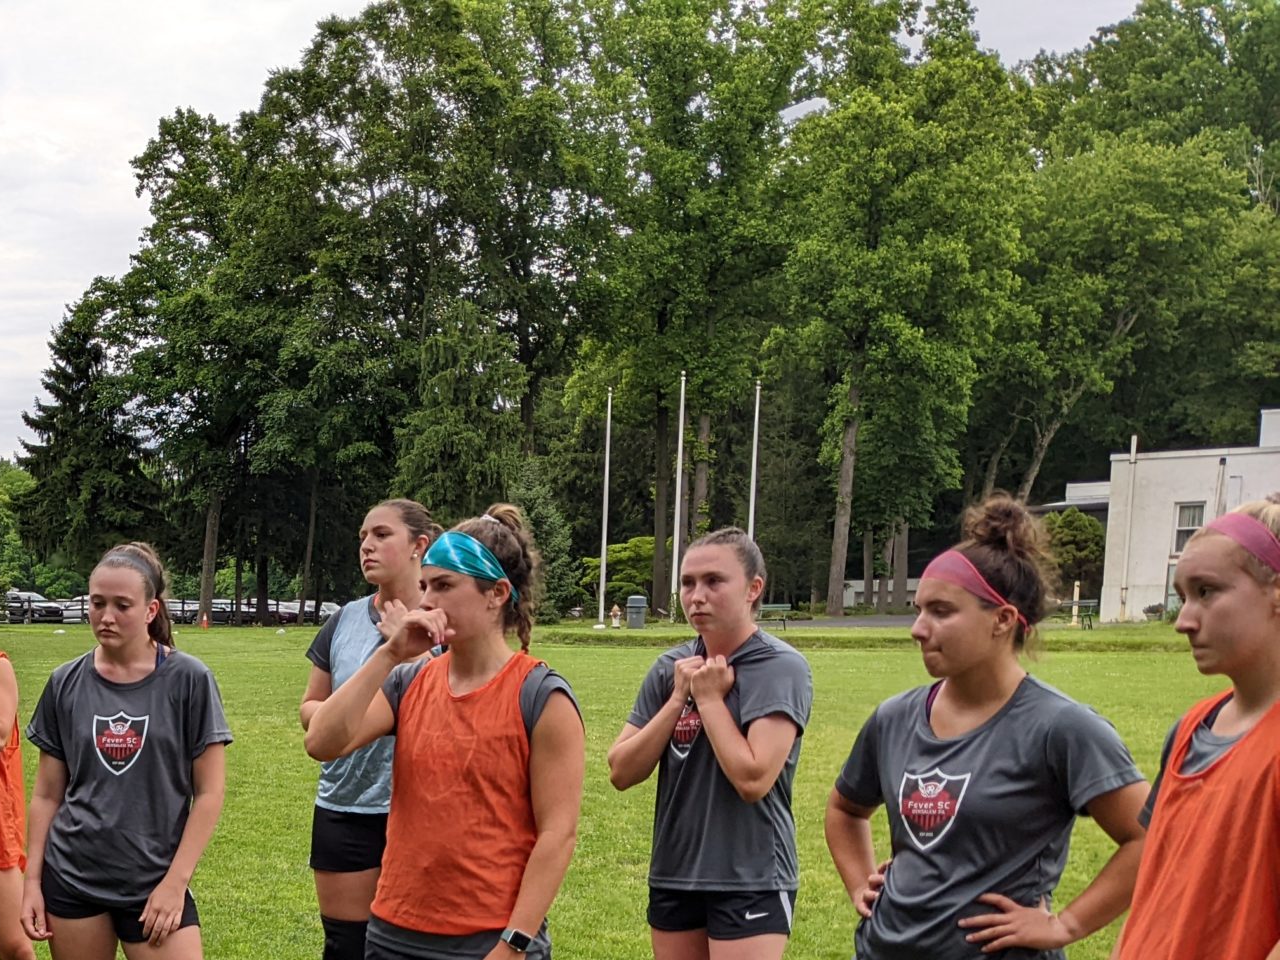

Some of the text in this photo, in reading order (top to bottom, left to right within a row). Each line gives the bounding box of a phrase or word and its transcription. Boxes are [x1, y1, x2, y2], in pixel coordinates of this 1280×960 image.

[102, 736, 123, 744] Fever
[908, 801, 951, 810] Fever SC
